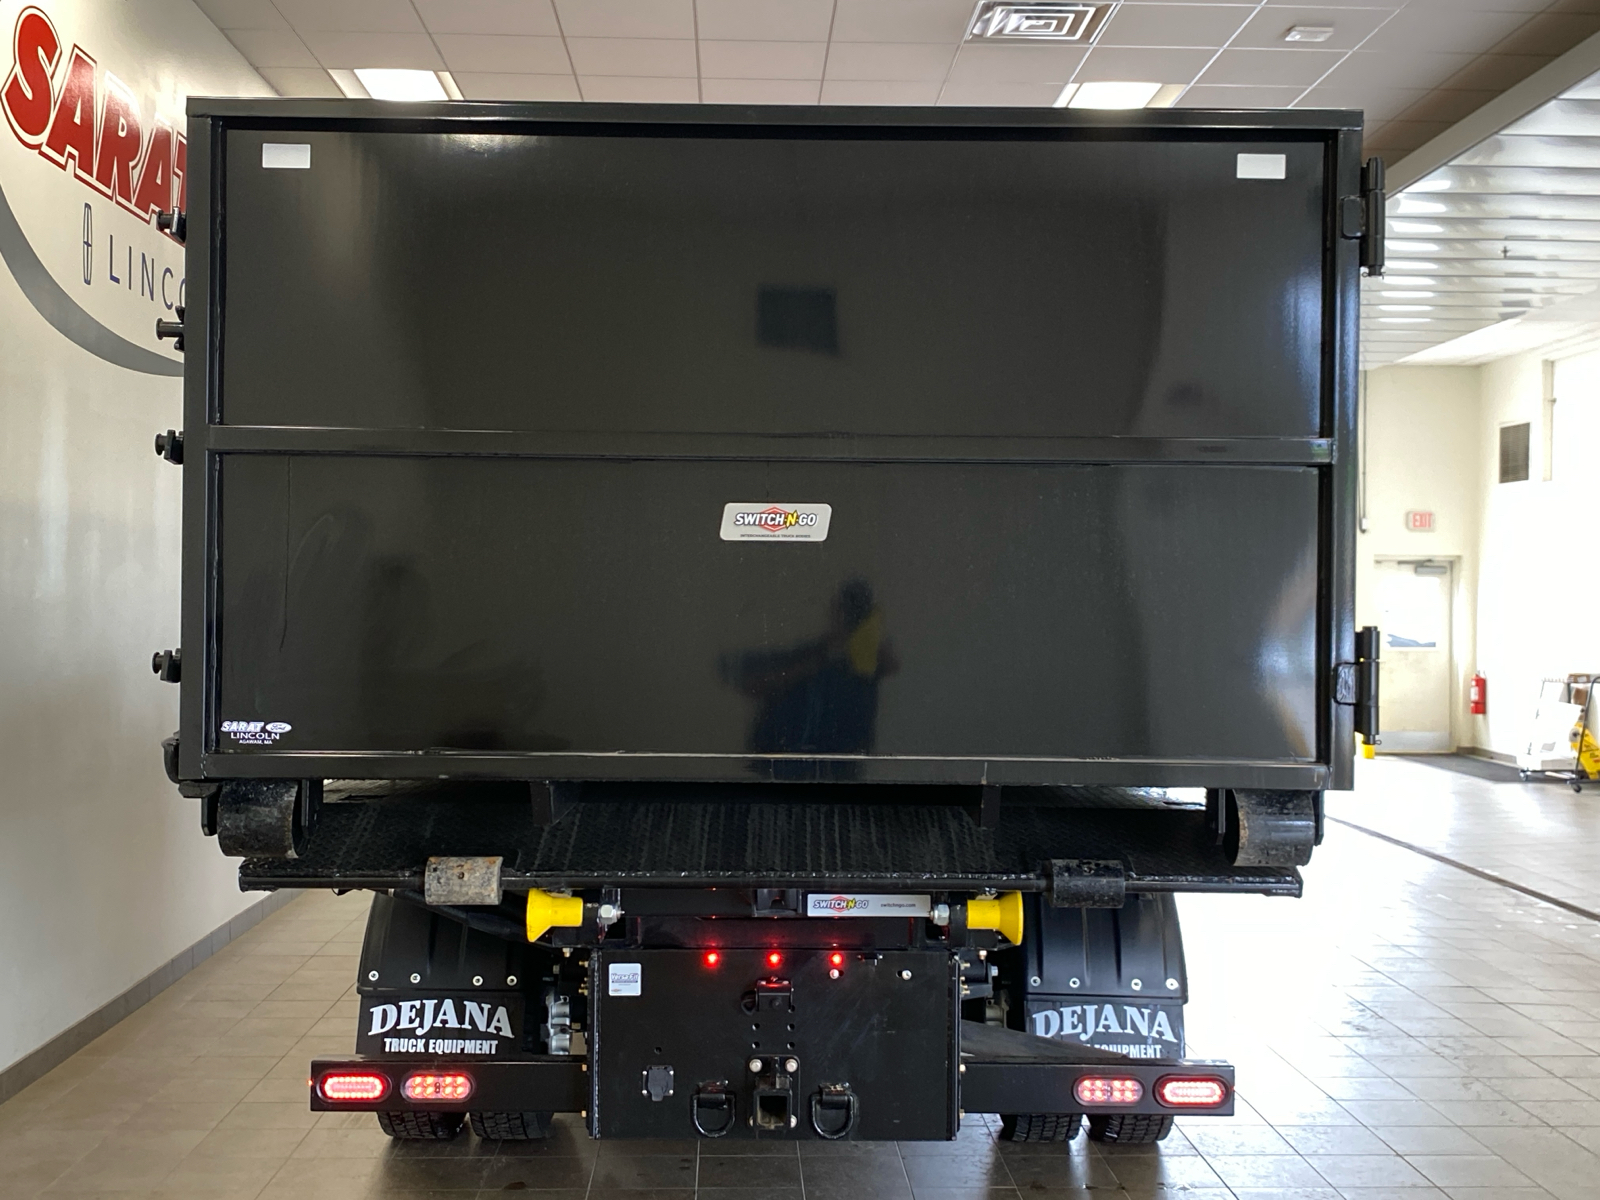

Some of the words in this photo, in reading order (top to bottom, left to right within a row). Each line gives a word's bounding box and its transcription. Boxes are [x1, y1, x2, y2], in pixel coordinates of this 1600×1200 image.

[1412, 512, 1433, 528] EXIT
[221, 721, 265, 732] SARAT
[230, 732, 280, 740] LINCOLN
[368, 998, 515, 1038] DEJANA
[1032, 1004, 1178, 1043] DEJANA
[384, 1038, 426, 1053] TRUCK
[428, 1039, 498, 1055] EQUIPMENT
